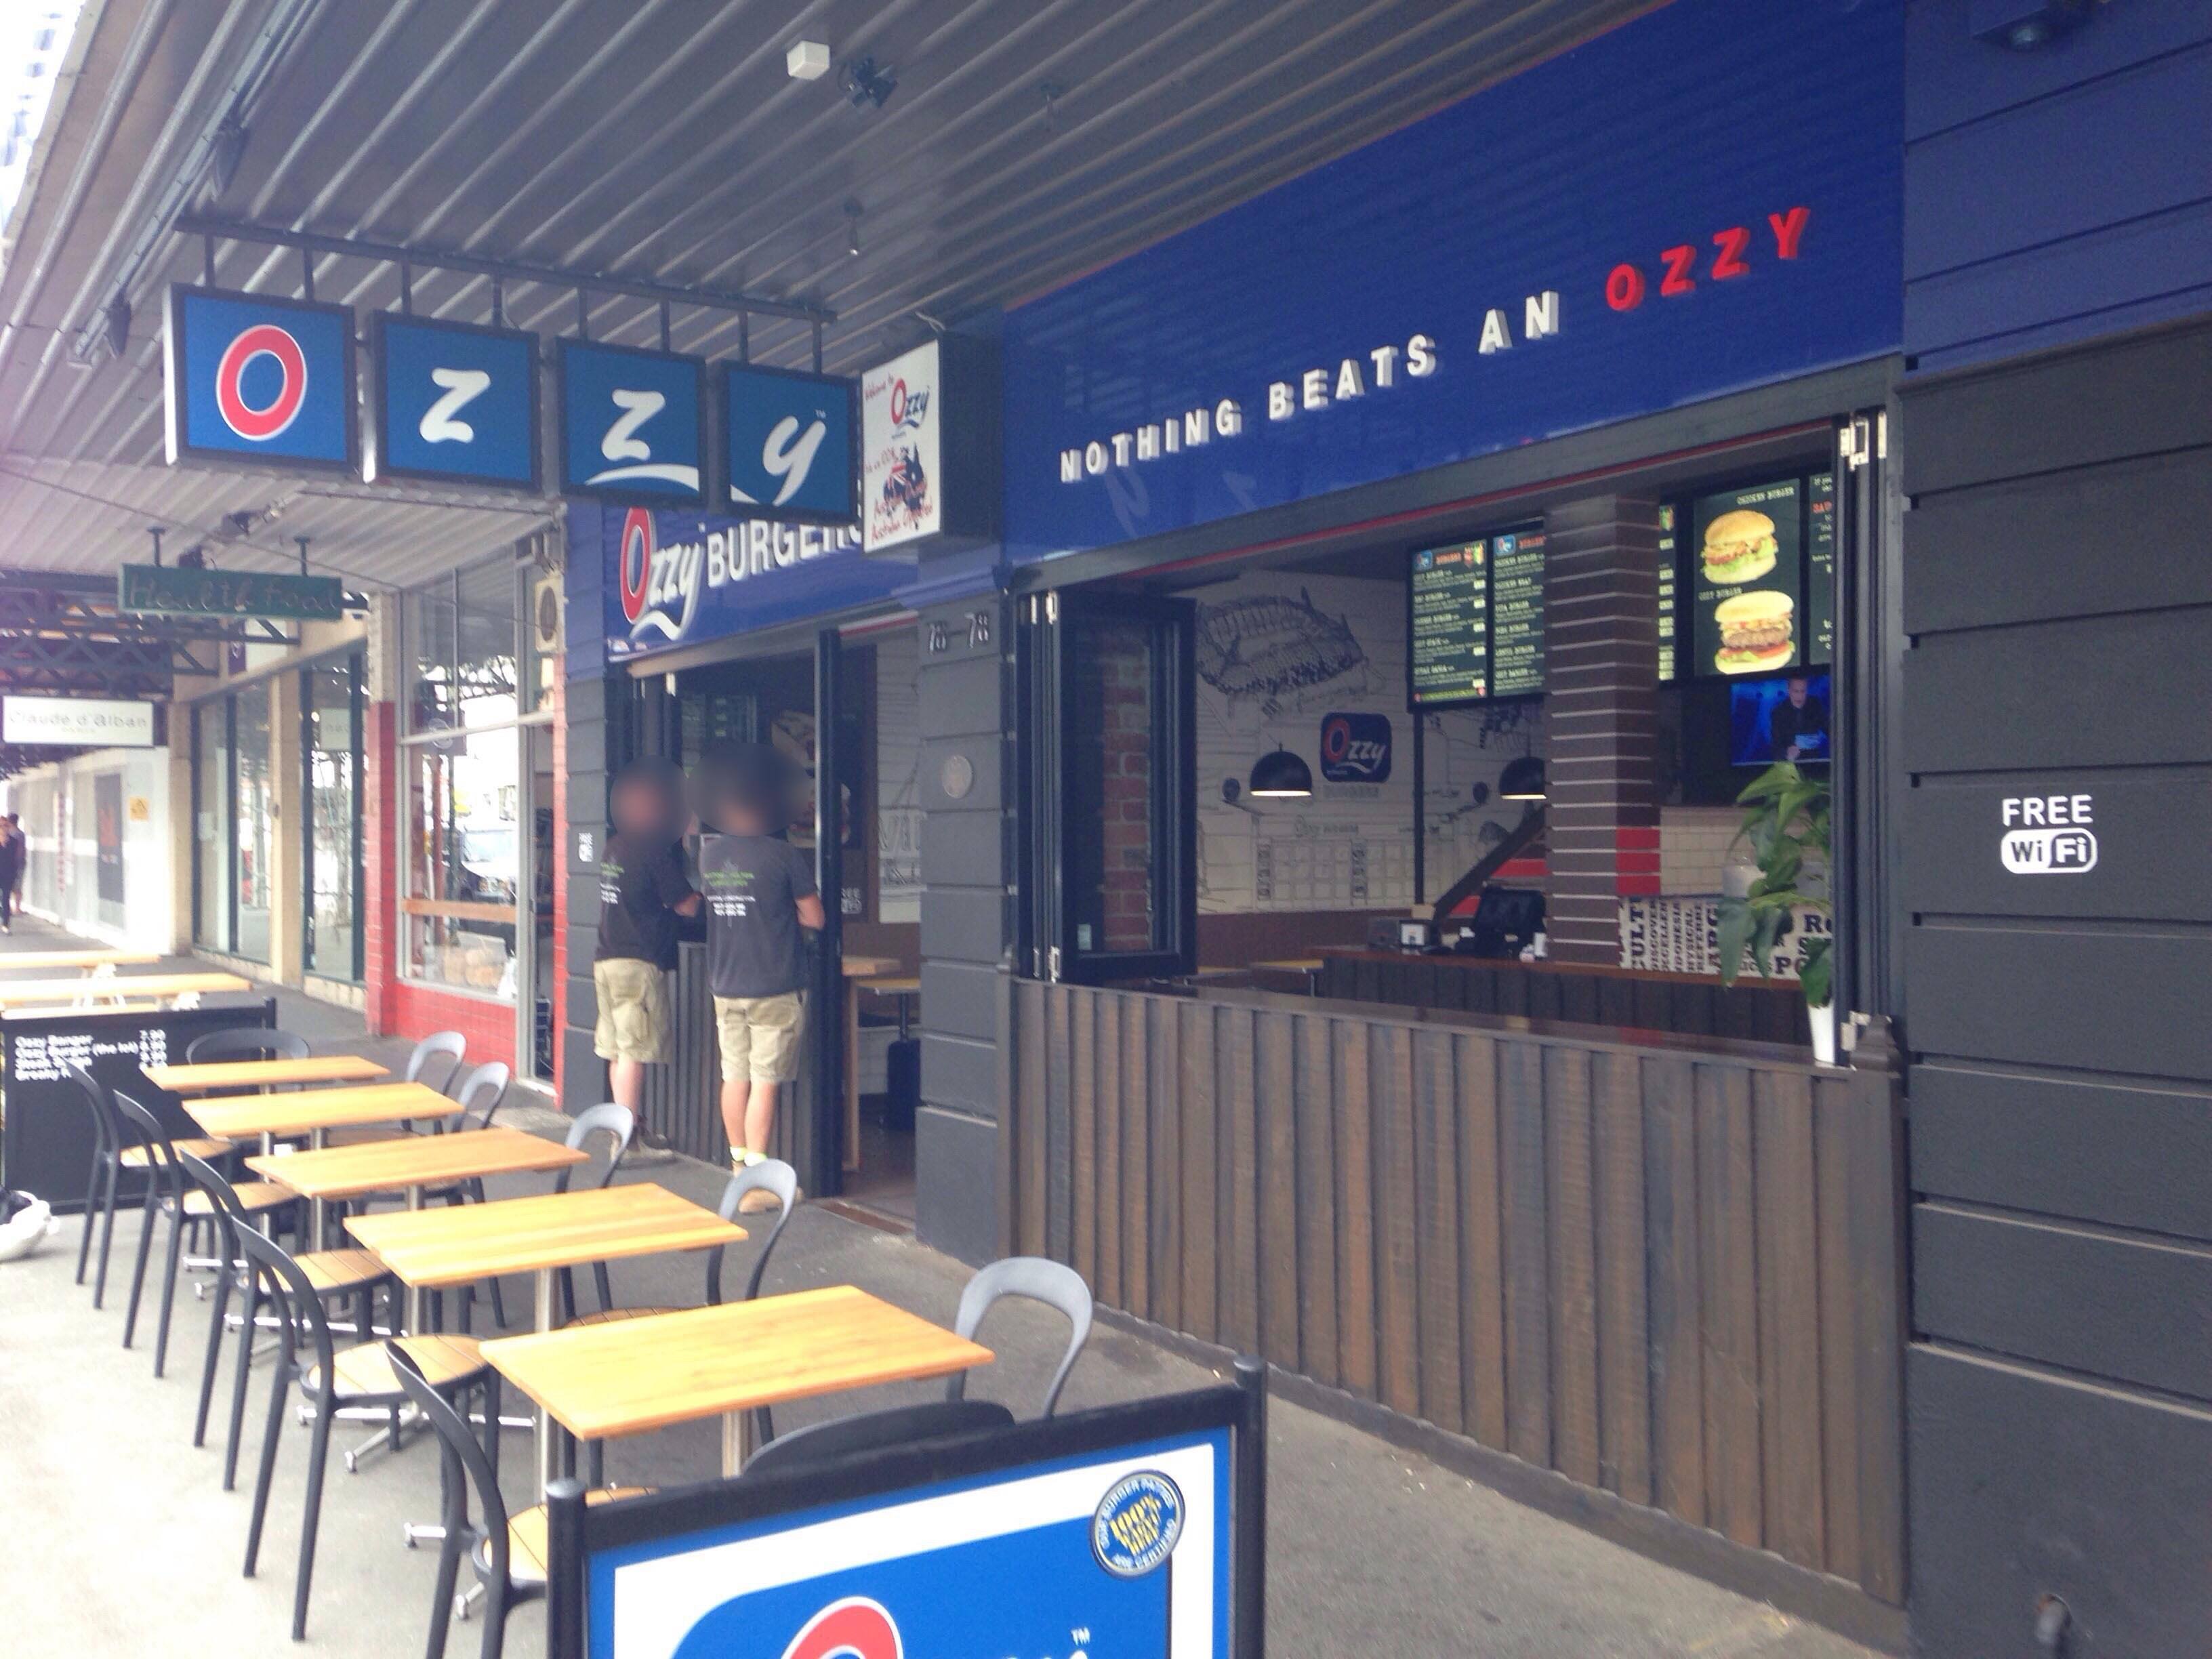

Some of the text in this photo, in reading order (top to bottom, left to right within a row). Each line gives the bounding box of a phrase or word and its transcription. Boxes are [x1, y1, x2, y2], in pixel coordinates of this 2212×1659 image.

[1060, 207, 1811, 483] NOTHING BEATS AN OZZY
[890, 378, 930, 428] Ozzy
[620, 507, 705, 641] Ozzy
[1324, 718, 1387, 775] Ozzy
[2002, 794, 2093, 827] FREE
[1071, 1627, 1090, 1645] TM
